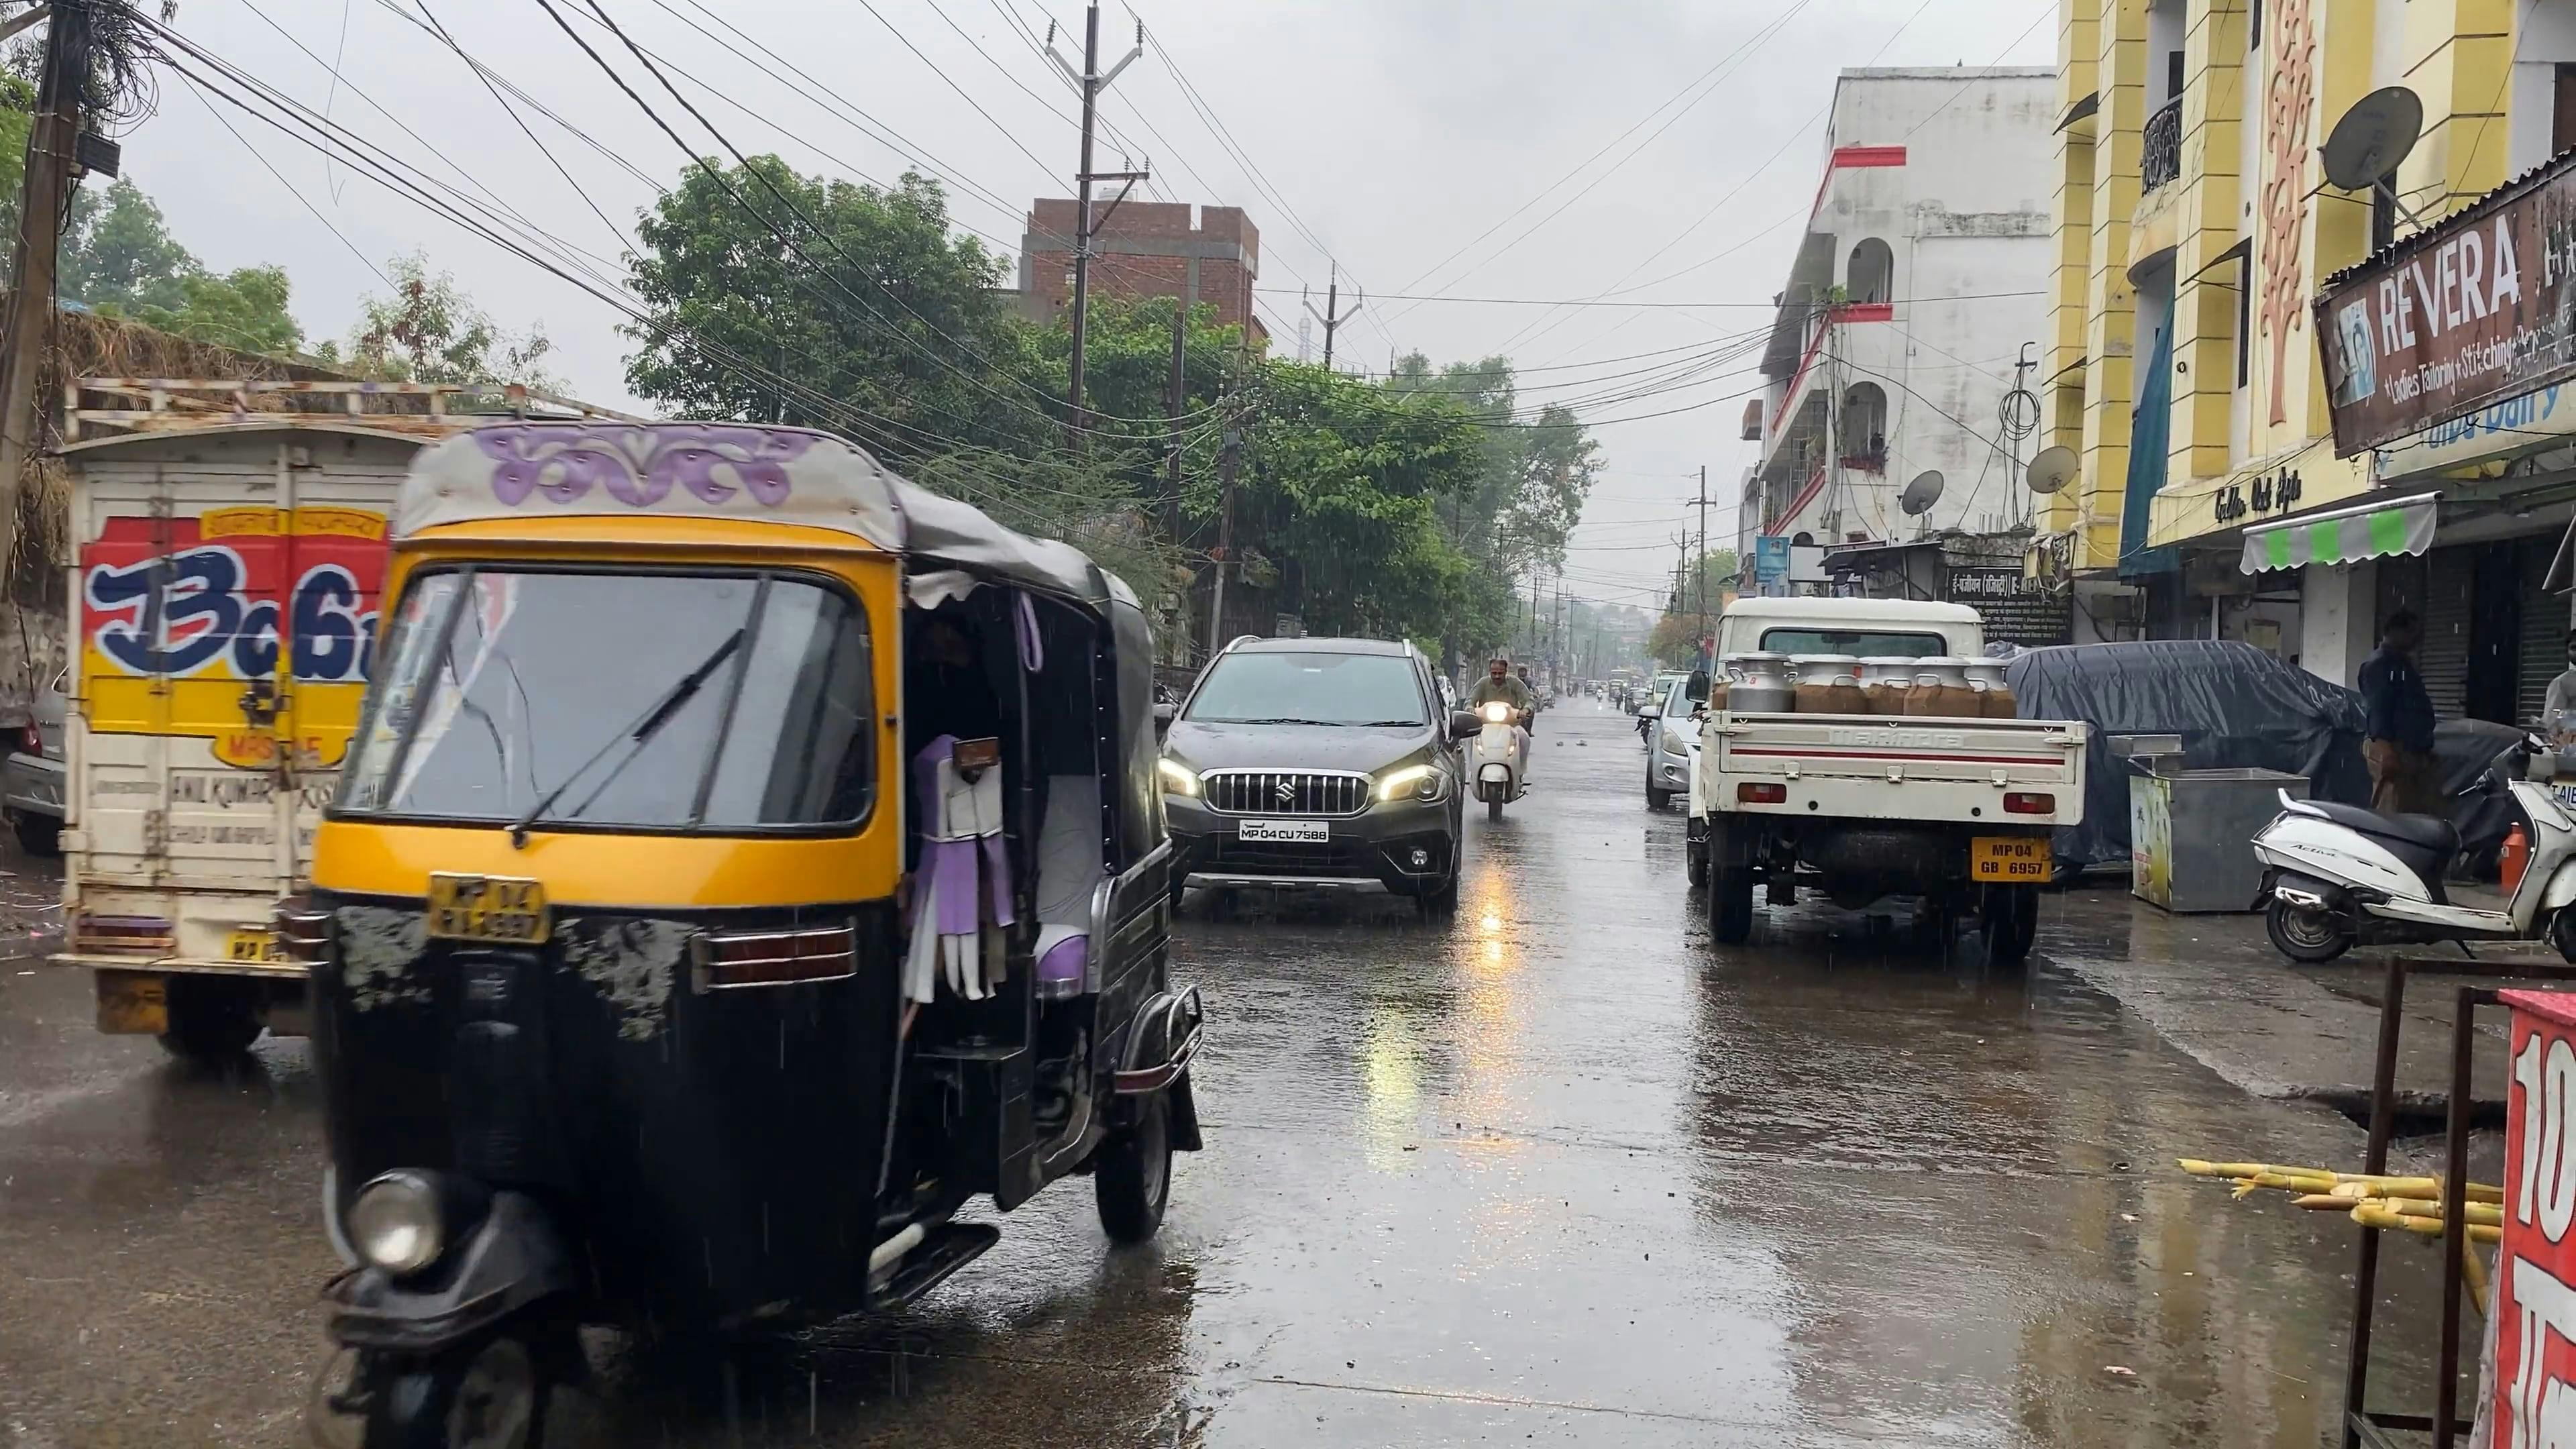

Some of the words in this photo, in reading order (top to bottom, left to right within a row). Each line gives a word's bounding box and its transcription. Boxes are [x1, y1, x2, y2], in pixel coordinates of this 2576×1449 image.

[2388, 368, 2420, 405] Ladies
[2419, 356, 2456, 396] Tailoring
[2461, 335, 2512, 380] Stitching
[1241, 829, 1259, 839] MP
[1260, 830, 1277, 839] 04
[1279, 830, 1294, 839] CU
[1295, 830, 1327, 840] 7588
[1992, 844, 2012, 857] MP
[2015, 845, 2032, 857] 04
[1981, 861, 1999, 873] GB
[2009, 862, 2043, 875] 6957
